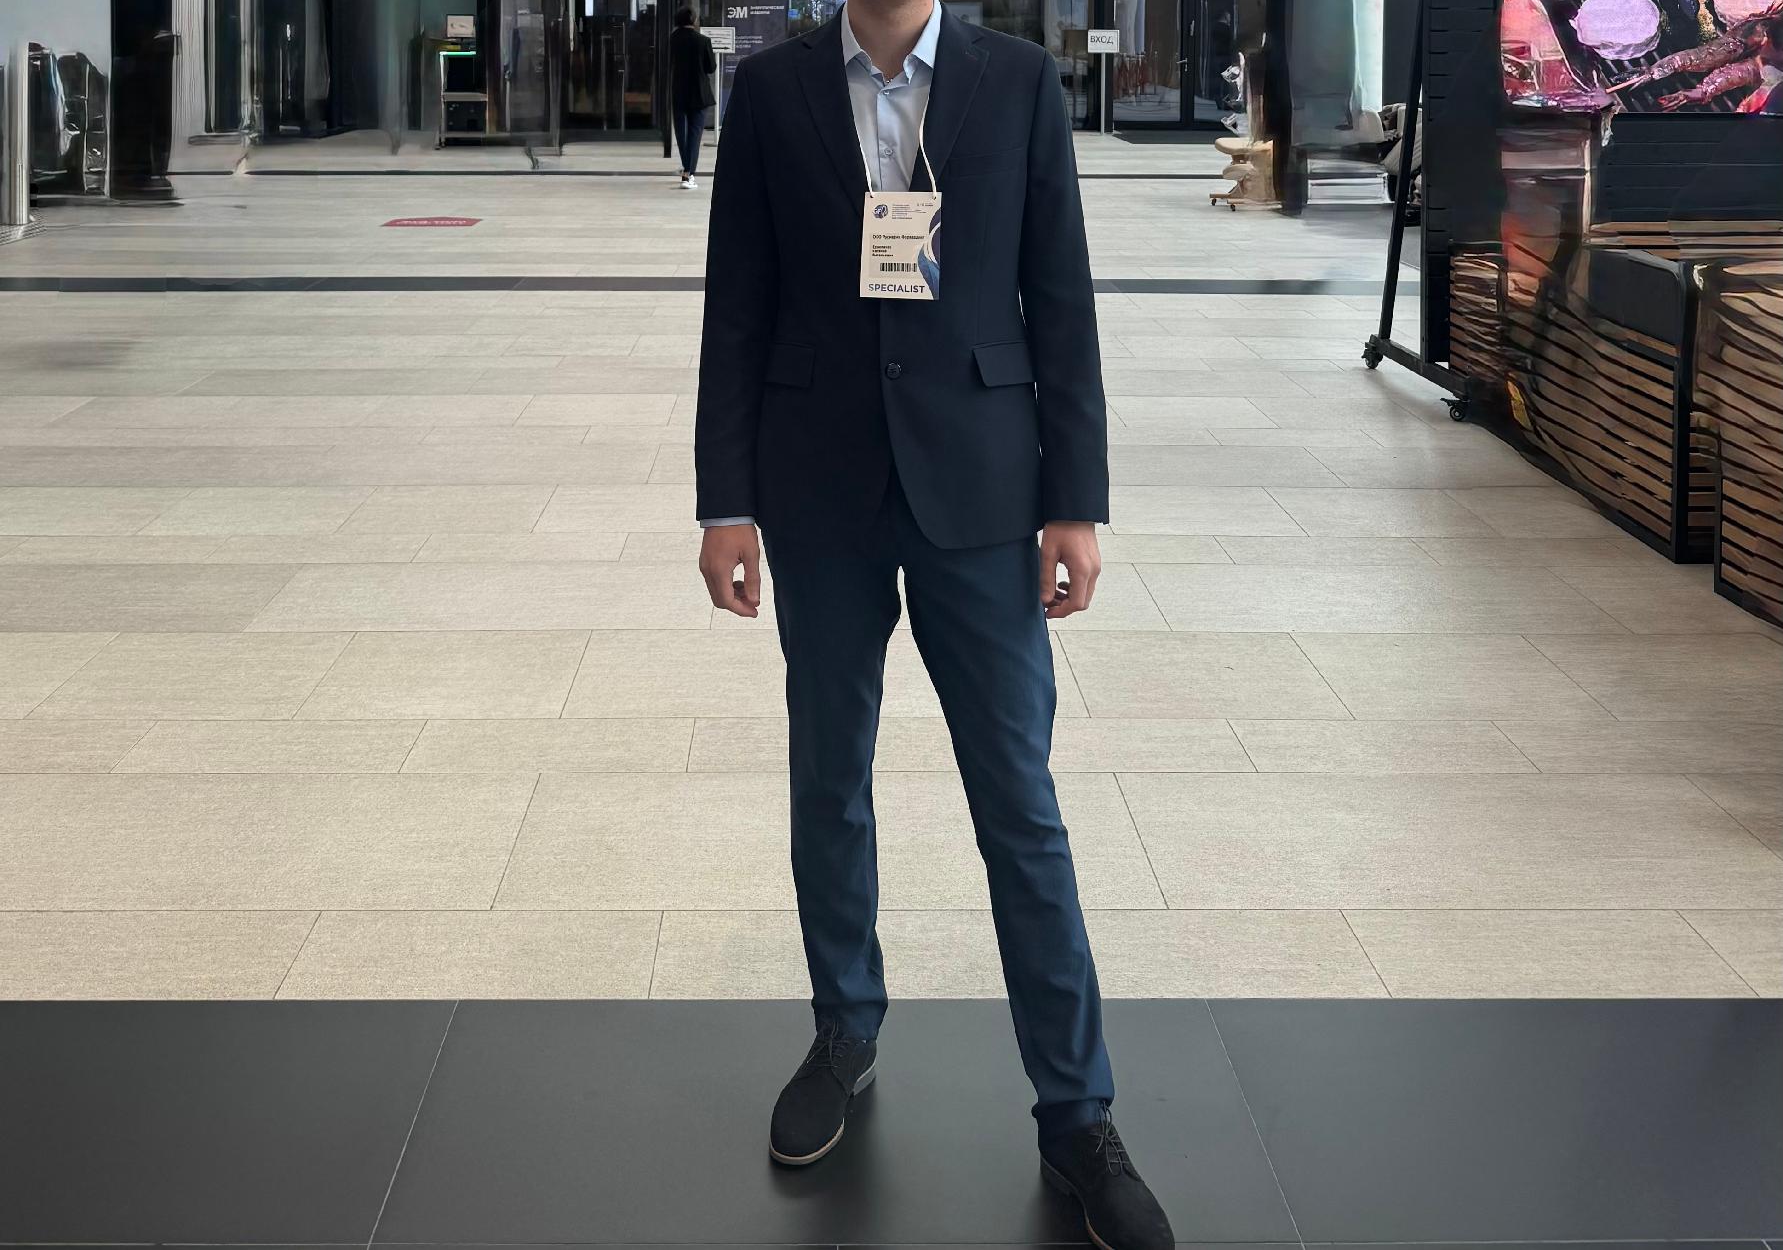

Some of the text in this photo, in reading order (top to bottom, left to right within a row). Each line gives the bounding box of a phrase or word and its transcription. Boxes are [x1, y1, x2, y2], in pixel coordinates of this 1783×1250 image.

[727, 6, 748, 19] ЭМ
[1090, 35, 1114, 45] ВХОД
[868, 283, 925, 294] SPECIALIST
